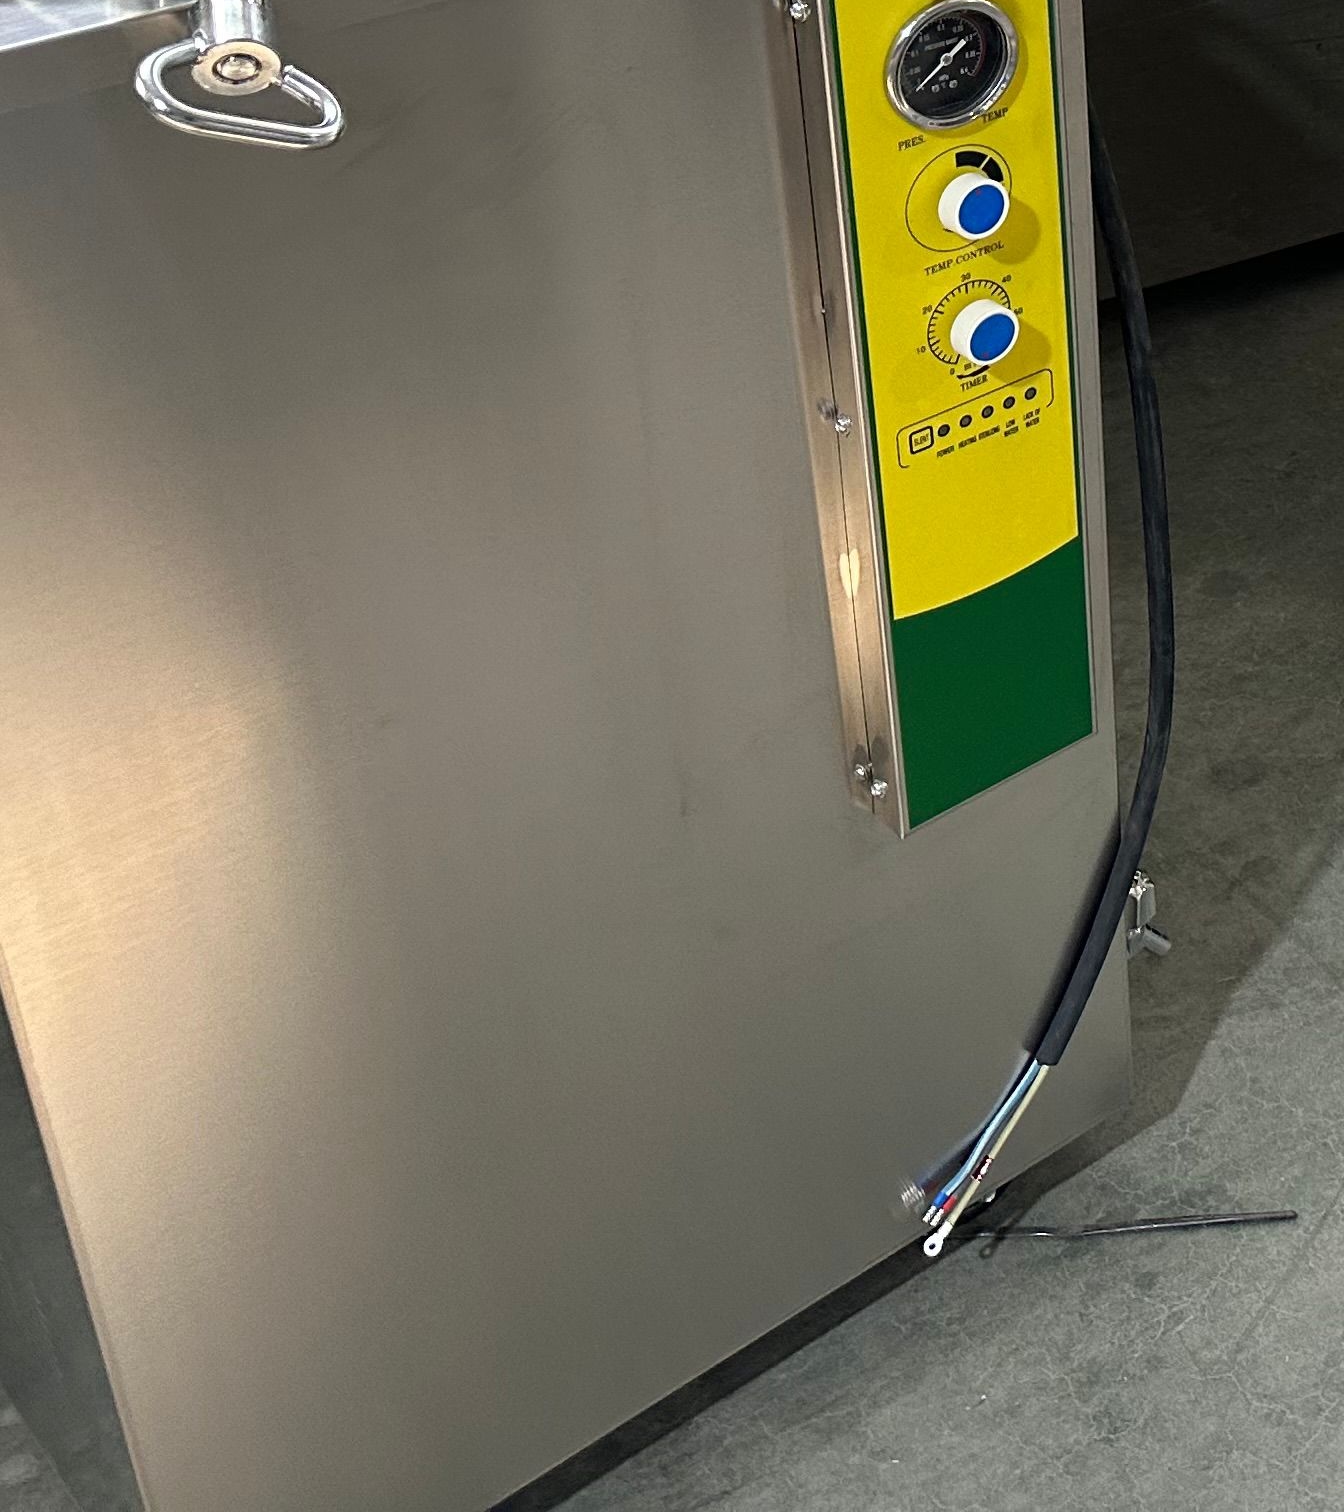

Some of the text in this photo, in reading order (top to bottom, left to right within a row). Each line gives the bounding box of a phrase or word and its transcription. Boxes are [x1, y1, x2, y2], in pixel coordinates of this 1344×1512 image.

[982, 107, 1009, 124] TEMP
[924, 240, 1005, 276] TEMP CONTROL
[922, 304, 933, 315] 20
[960, 374, 989, 392] TIMER
